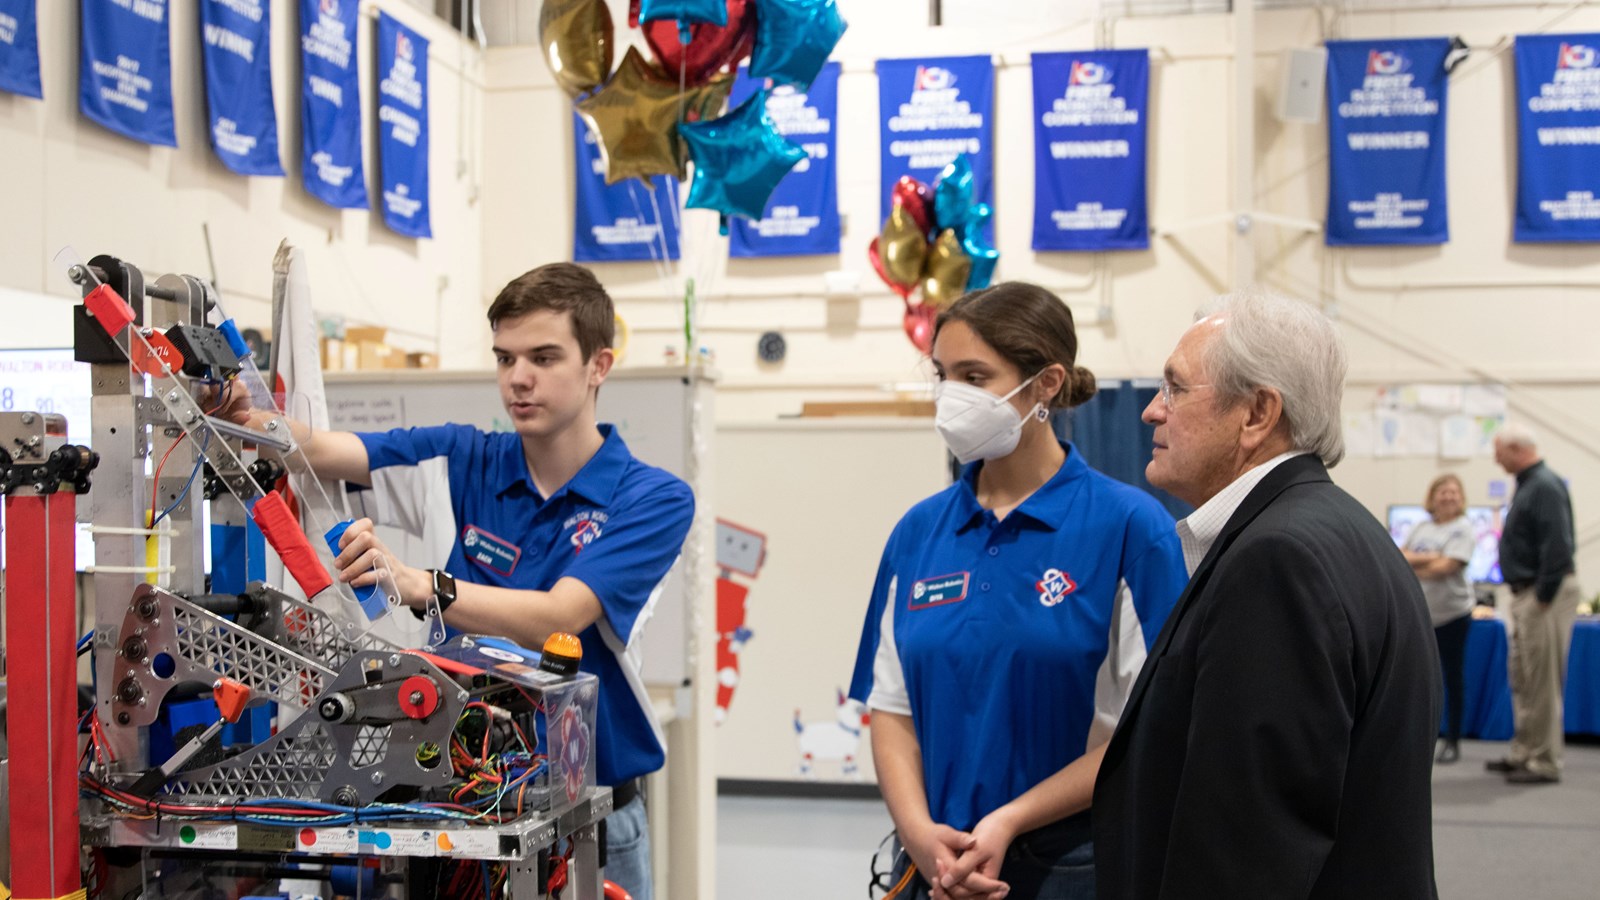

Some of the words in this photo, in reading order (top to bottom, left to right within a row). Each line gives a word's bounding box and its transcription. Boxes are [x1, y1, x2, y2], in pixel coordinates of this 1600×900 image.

[1363, 73, 1414, 89] FIRST
[1351, 87, 1426, 102] ROBOTICS
[1042, 109, 1138, 127] COMPETITION
[1339, 100, 1439, 118] COMPETITION
[1348, 131, 1429, 150] WINNER
[1537, 126, 1600, 145] WINNE
[1050, 139, 1129, 159] WINNER
[1049, 580, 1064, 593] W
